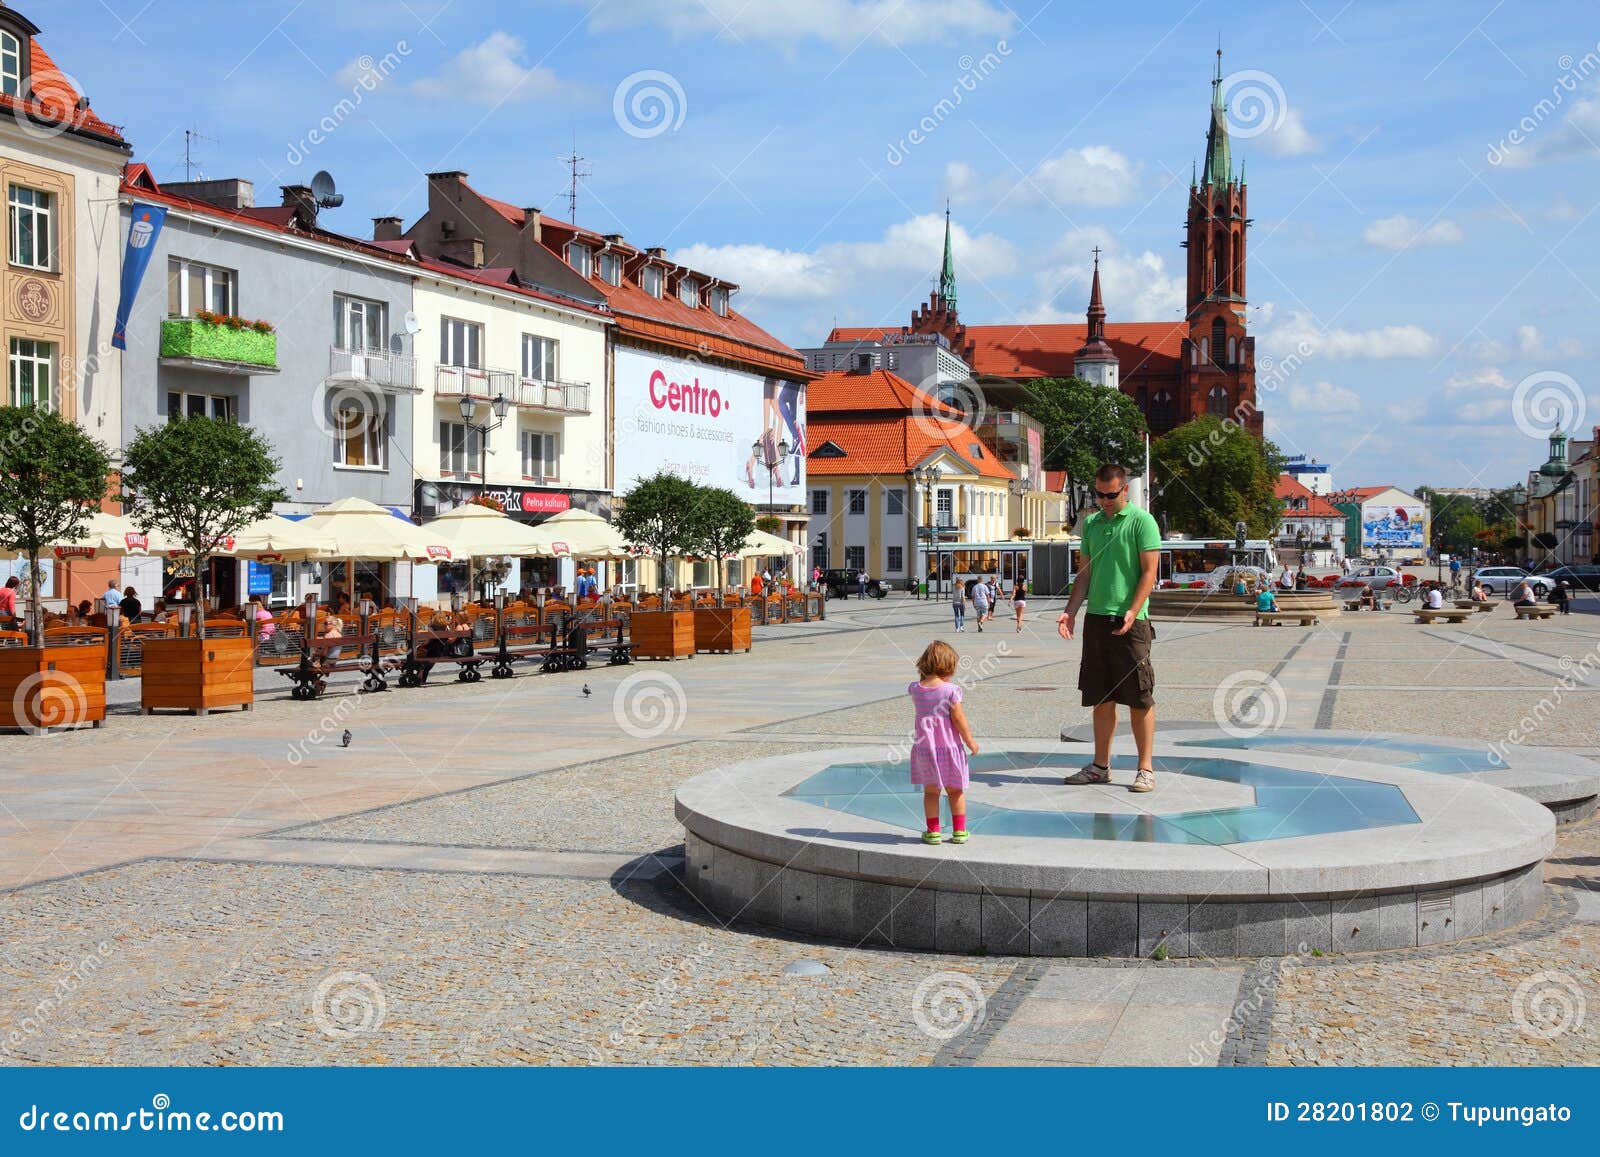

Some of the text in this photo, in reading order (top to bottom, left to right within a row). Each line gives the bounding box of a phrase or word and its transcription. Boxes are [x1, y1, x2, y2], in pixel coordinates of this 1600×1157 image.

[649, 369, 721, 418] Centro
[637, 418, 666, 434] fashion
[667, 421, 689, 437] shoes
[696, 427, 733, 443] accessories
